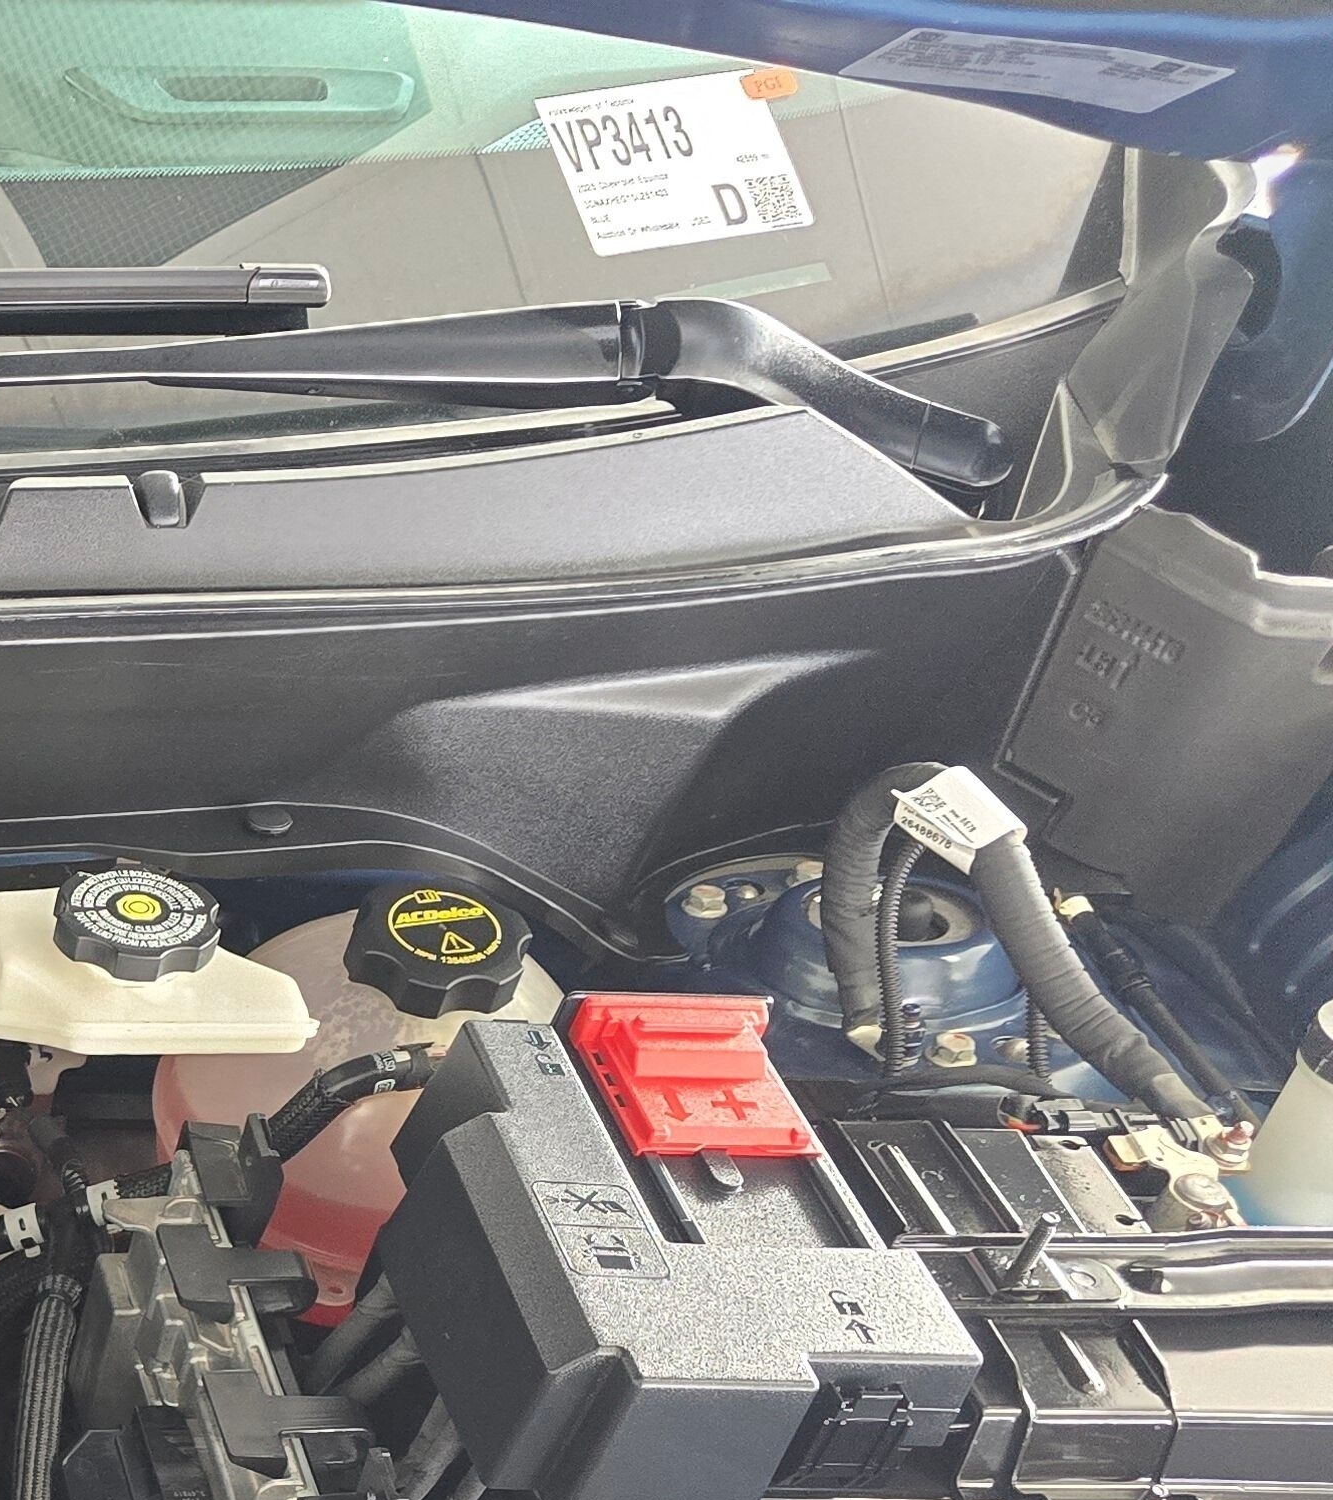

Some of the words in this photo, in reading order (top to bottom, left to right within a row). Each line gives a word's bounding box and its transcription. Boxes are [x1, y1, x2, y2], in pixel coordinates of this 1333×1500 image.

[551, 106, 694, 173] VP3413
[711, 183, 748, 226] D
[395, 907, 485, 924] ACDelco
